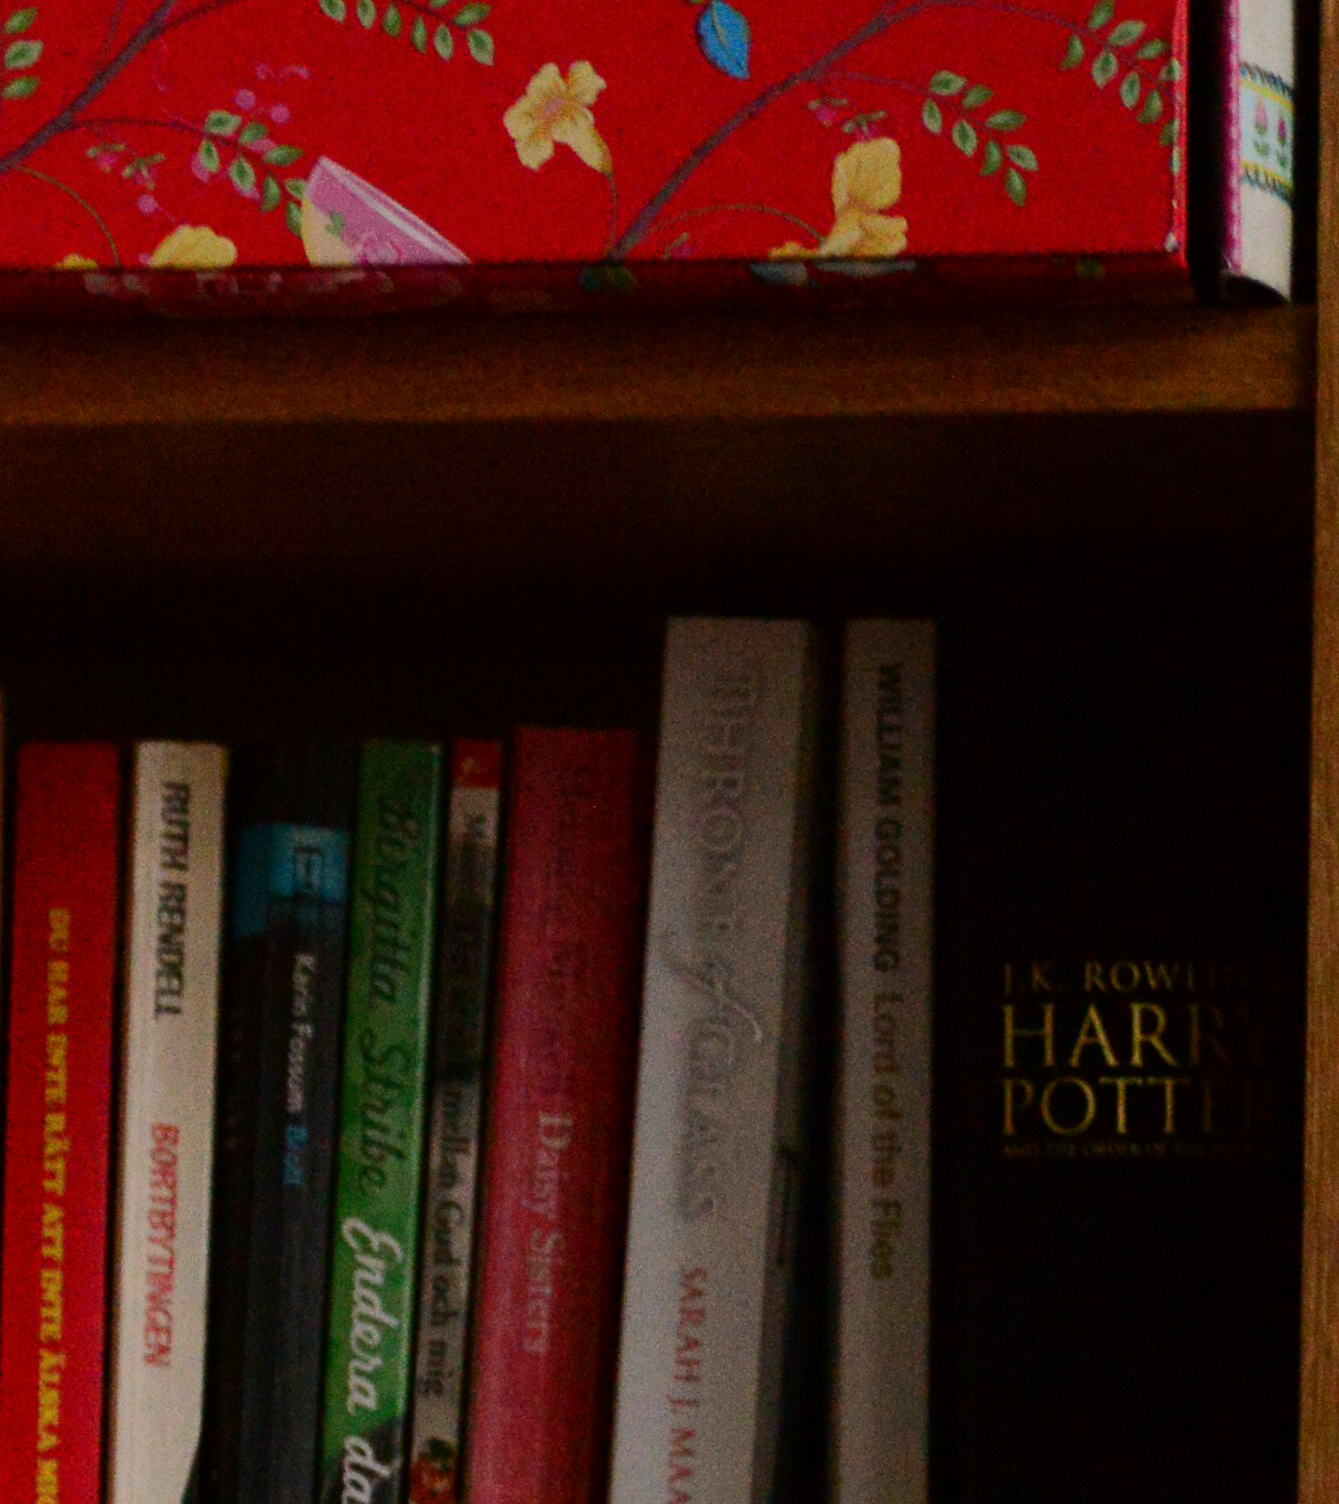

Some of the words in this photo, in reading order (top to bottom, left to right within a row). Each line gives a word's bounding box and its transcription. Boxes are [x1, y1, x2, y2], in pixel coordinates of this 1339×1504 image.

[873, 662, 905, 806] WILLIAM
[159, 780, 191, 874] RUTH
[45, 906, 73, 945] DU
[872, 816, 904, 972] GOLDING
[45, 956, 71, 1024] HAR
[153, 881, 189, 1022] RENDELL
[291, 952, 318, 1018] Karin
[44, 1032, 70, 1106] INTE
[285, 1022, 315, 1115] Fossum
[871, 991, 904, 1077] Lord
[435, 1094, 473, 1191] mellan
[872, 1086, 904, 1124] of
[41, 1113, 73, 1194] RÄTT
[525, 1111, 572, 1221] Daisy
[871, 1130, 903, 1189] the
[39, 1201, 67, 1261] ATT
[143, 1121, 180, 1368] BORTBYTINGEN
[428, 1200, 465, 1266] Gud
[869, 1195, 903, 1281] Flies
[37, 1268, 66, 1343] INTE
[338, 1215, 405, 1414] Endera
[427, 1270, 460, 1327] och
[525, 1230, 570, 1355] Sisters
[673, 1263, 710, 1379] SARAH
[35, 1347, 68, 1450] ÄLSKA
[419, 1335, 455, 1397] mig
